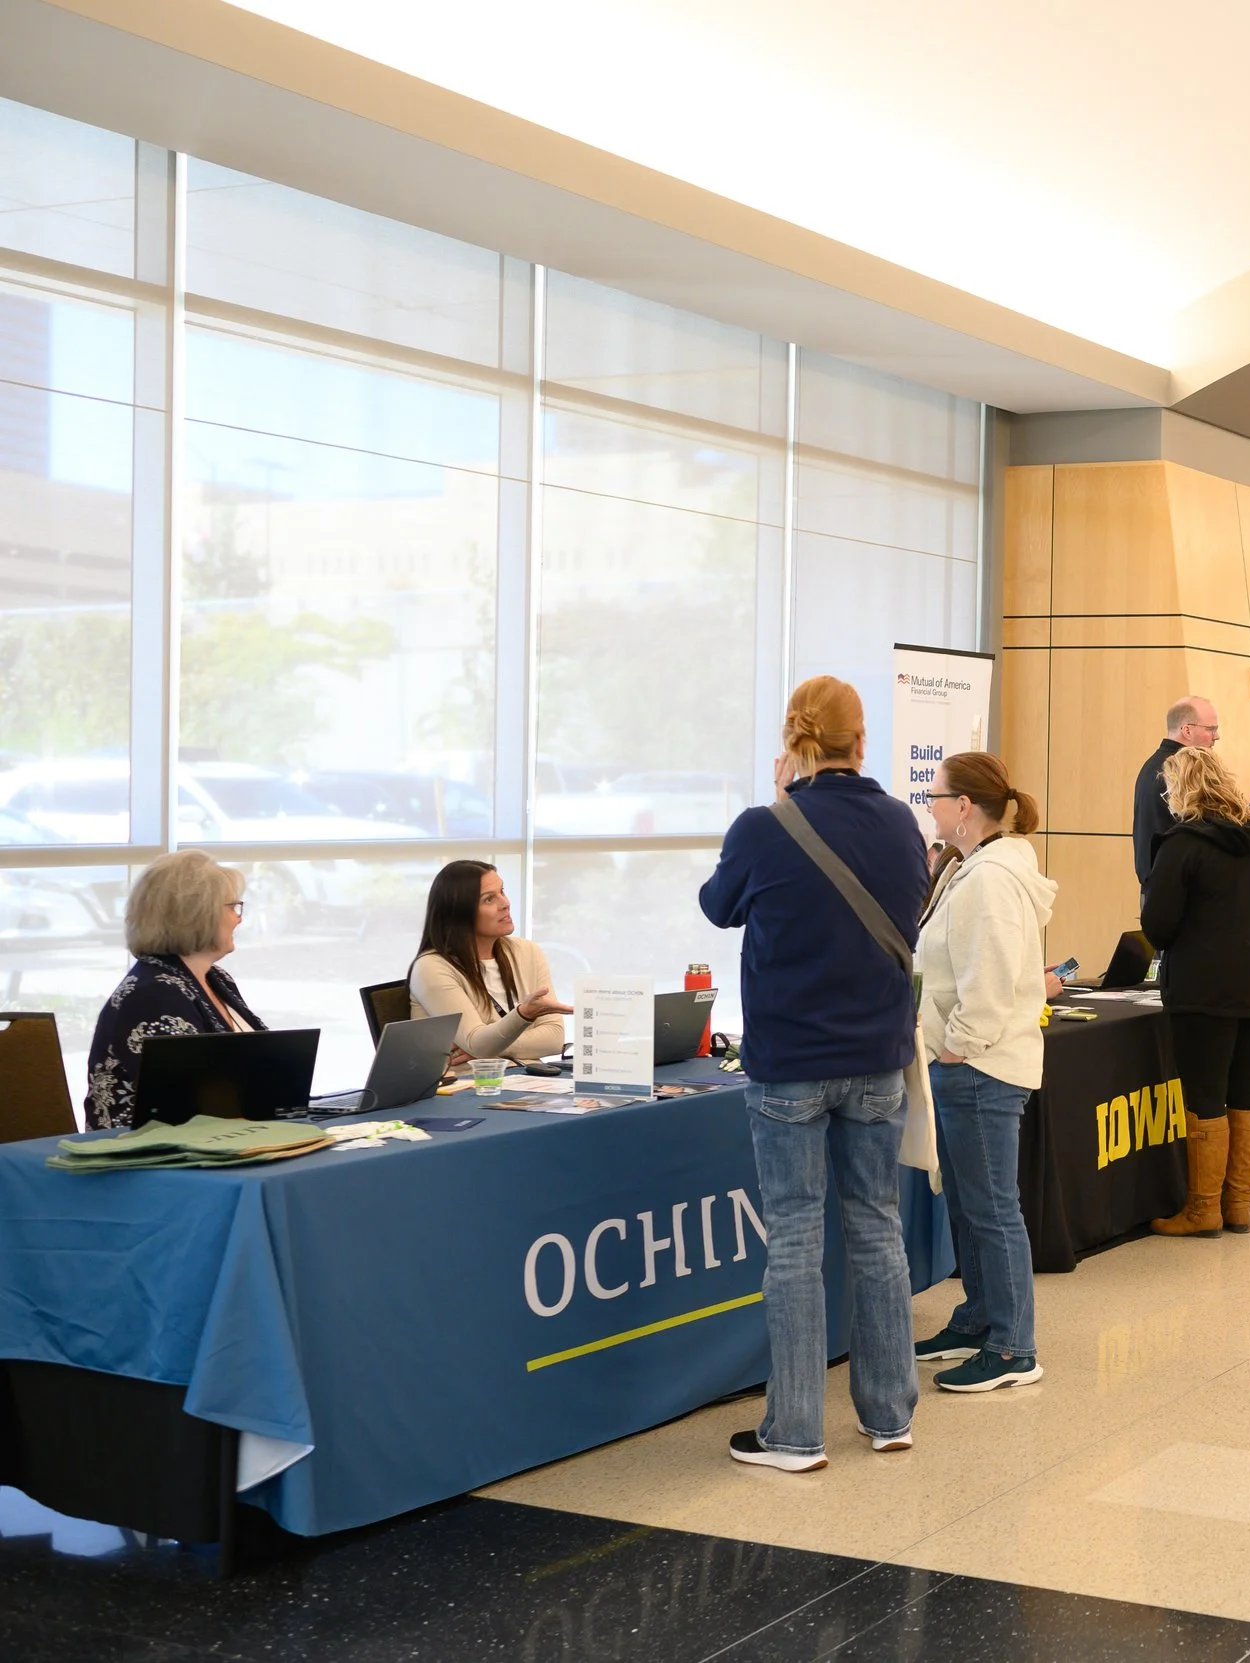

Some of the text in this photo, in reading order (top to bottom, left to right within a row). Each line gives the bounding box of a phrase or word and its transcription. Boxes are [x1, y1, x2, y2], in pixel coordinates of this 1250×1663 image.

[911, 675, 971, 691] Mutual of America
[911, 687, 948, 698] Financial Group
[910, 744, 943, 761] Build
[1095, 1078, 1187, 1170] IOWA
